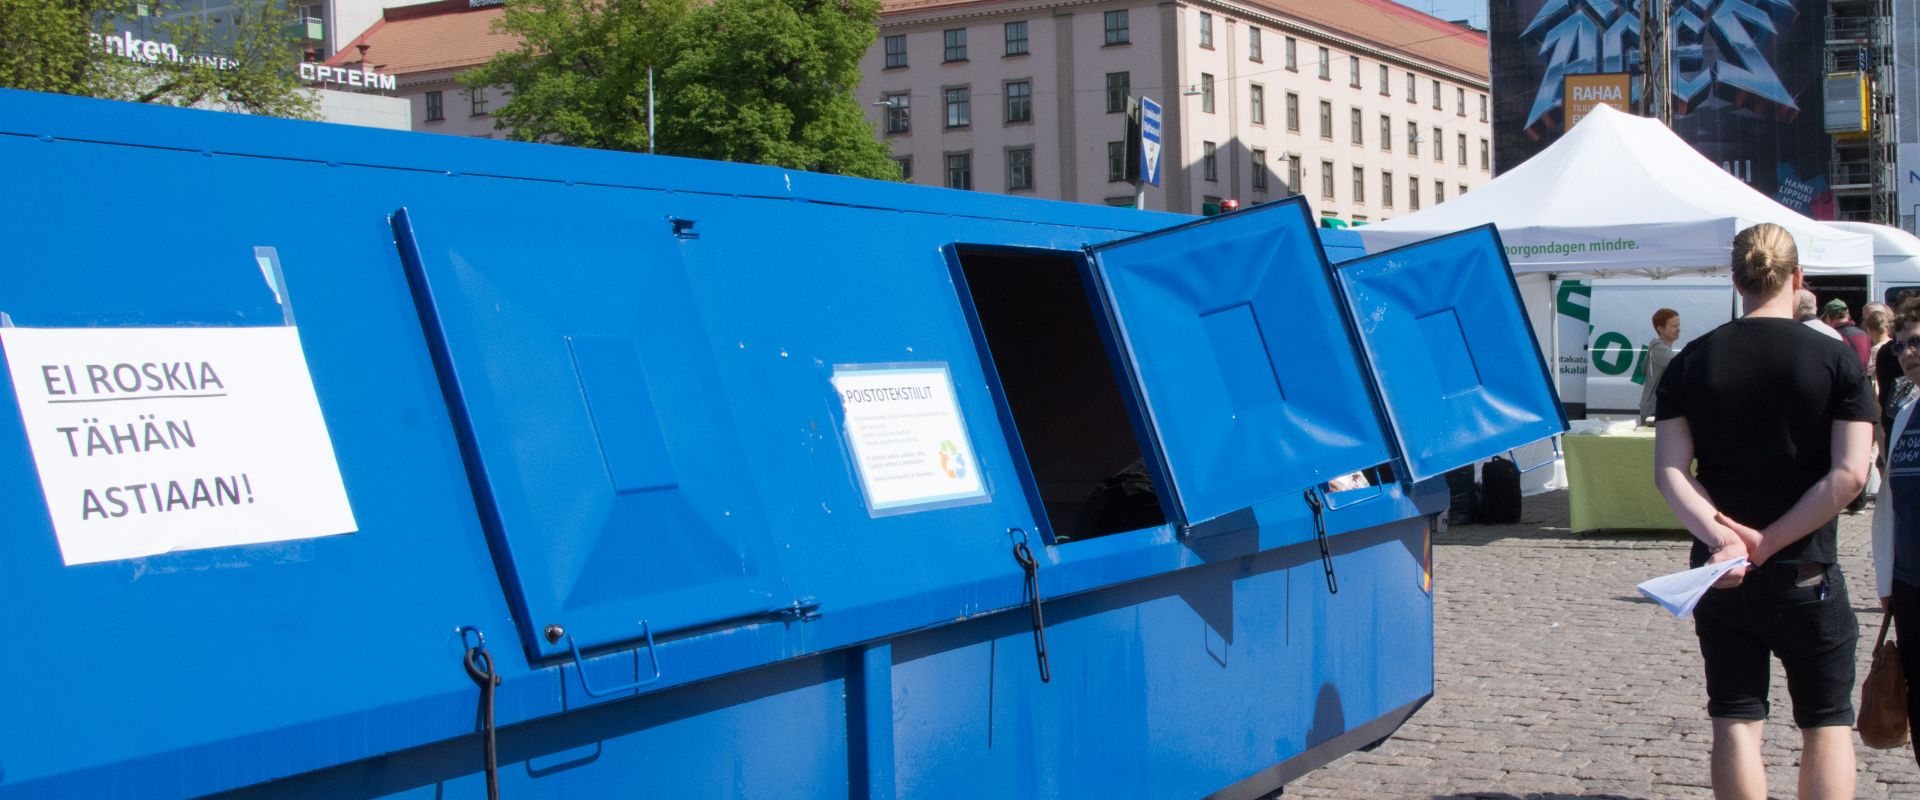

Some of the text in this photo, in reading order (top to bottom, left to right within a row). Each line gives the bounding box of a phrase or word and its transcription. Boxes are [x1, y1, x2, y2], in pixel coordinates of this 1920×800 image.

[1573, 85, 1622, 101] RAHAA
[1779, 186, 1812, 203] LIPPUSI
[1784, 178, 1814, 194] HANKI
[1589, 238, 1640, 251] mindre.
[41, 361, 225, 396] EI ROSKIA
[845, 386, 933, 404] POISTOTEKSTIILIT
[56, 413, 197, 458] TÄHÄN
[82, 473, 255, 521] ASTIAAN!
